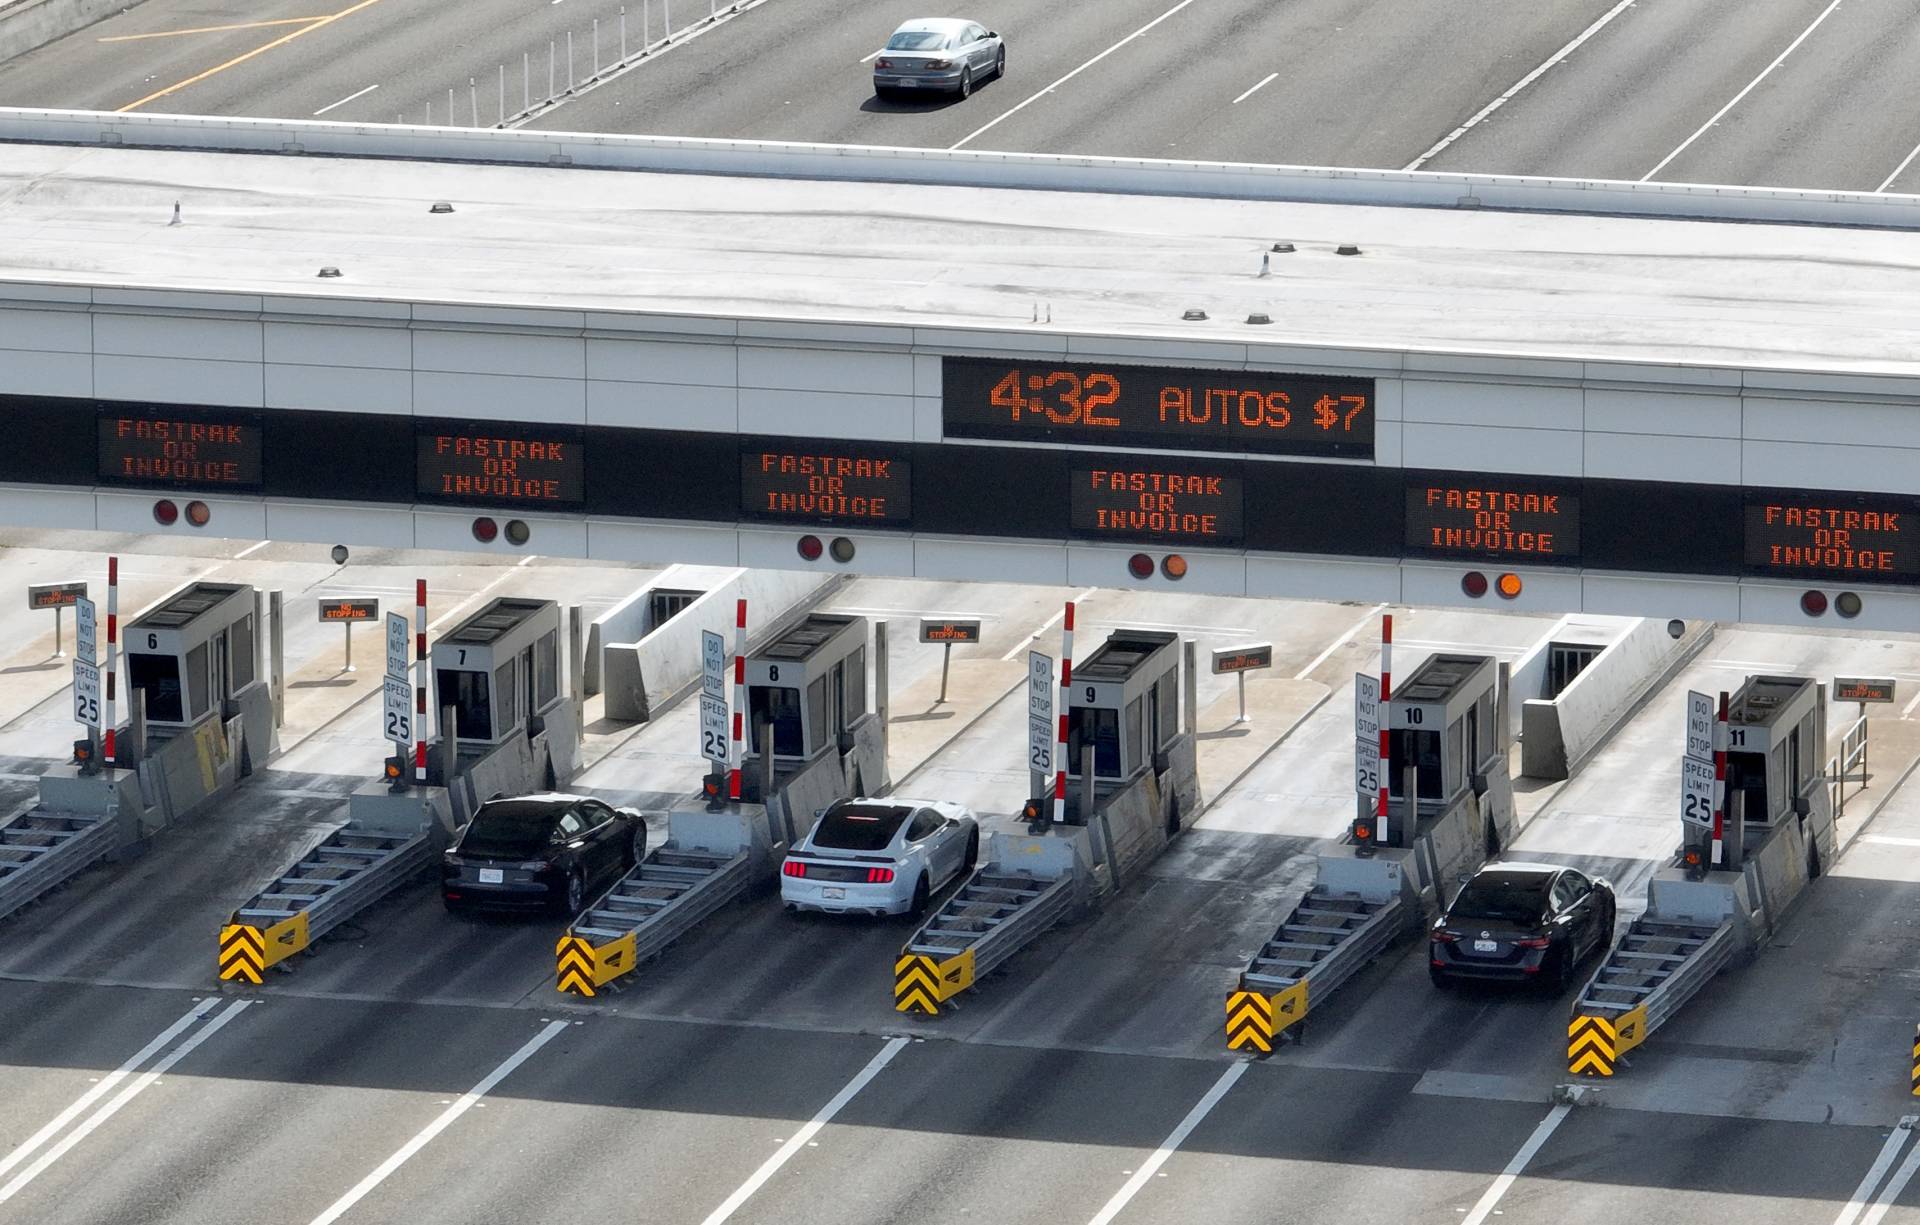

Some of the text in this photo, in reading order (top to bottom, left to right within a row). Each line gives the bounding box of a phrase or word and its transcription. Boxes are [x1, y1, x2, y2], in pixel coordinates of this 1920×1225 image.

[990, 368, 1365, 431] 4:32 AUTOS $7
[117, 420, 241, 443] FASTRAK
[162, 441, 197, 459] OR
[435, 435, 564, 461] FASTRAK
[122, 457, 239, 481] INVOICE
[483, 458, 517, 477] OR
[761, 453, 891, 479] FASTRAK
[442, 474, 560, 499] INVOICE
[808, 475, 843, 495] OR
[1091, 471, 1222, 495] FASTRAK
[767, 491, 887, 517] INVOICE
[1139, 492, 1175, 512] OR
[1426, 488, 1559, 514] FASTRAK
[1096, 509, 1217, 534] INVOICE
[1474, 510, 1512, 530] OR
[1764, 505, 1900, 532] FASTRAK
[1431, 527, 1553, 553] INVOICE
[1814, 528, 1850, 549] OR
[1769, 544, 1895, 571] INVOICE
[340, 603, 352, 611] NO
[393, 622, 402, 635] DO
[147, 633, 158, 649] 6
[389, 656, 406, 672] STOP
[459, 649, 466, 665] 7
[706, 658, 720, 672] NOT
[76, 666, 98, 681] SPEED
[769, 665, 779, 681] 8
[1036, 661, 1046, 675] DO
[386, 682, 410, 699] SPEED
[706, 676, 722, 691] STOP
[1033, 679, 1048, 694] NOT
[1362, 683, 1373, 697] DO
[1086, 687, 1095, 703] 9
[78, 695, 98, 722] 25
[702, 701, 726, 717] SPEED
[1032, 696, 1050, 712] STOP
[1360, 702, 1375, 716] NOT
[1695, 701, 1707, 715] DO
[705, 715, 724, 730] LIMIT
[1405, 707, 1423, 724] 10
[388, 712, 410, 740] 25
[1359, 719, 1377, 734] STOP
[1692, 718, 1708, 734] NOT
[705, 730, 726, 759] 25
[1690, 737, 1710, 753] STOP
[1730, 730, 1745, 746] 11
[1032, 746, 1050, 768] 25
[1359, 769, 1377, 791] 25
[1685, 763, 1713, 780] SPEED
[1687, 779, 1710, 794] LIMIT
[1685, 794, 1711, 822] 25
